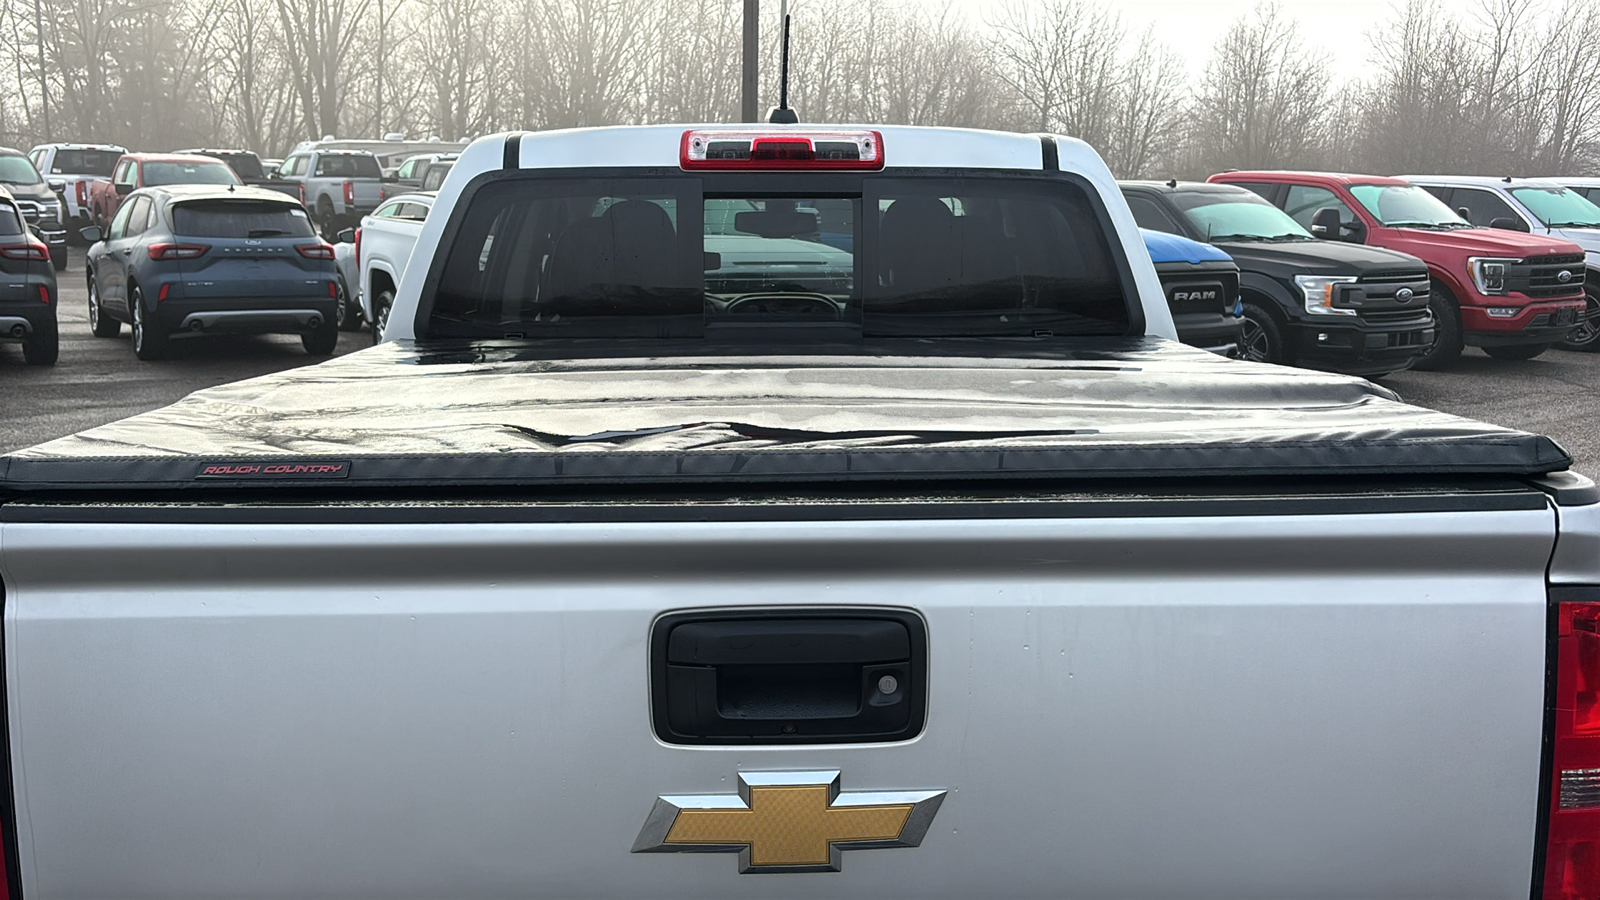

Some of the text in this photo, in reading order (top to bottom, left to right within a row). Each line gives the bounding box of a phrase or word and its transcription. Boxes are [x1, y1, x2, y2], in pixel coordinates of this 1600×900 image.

[1173, 290, 1216, 301] RAM
[203, 464, 343, 475] ROUGH COUNTRY
